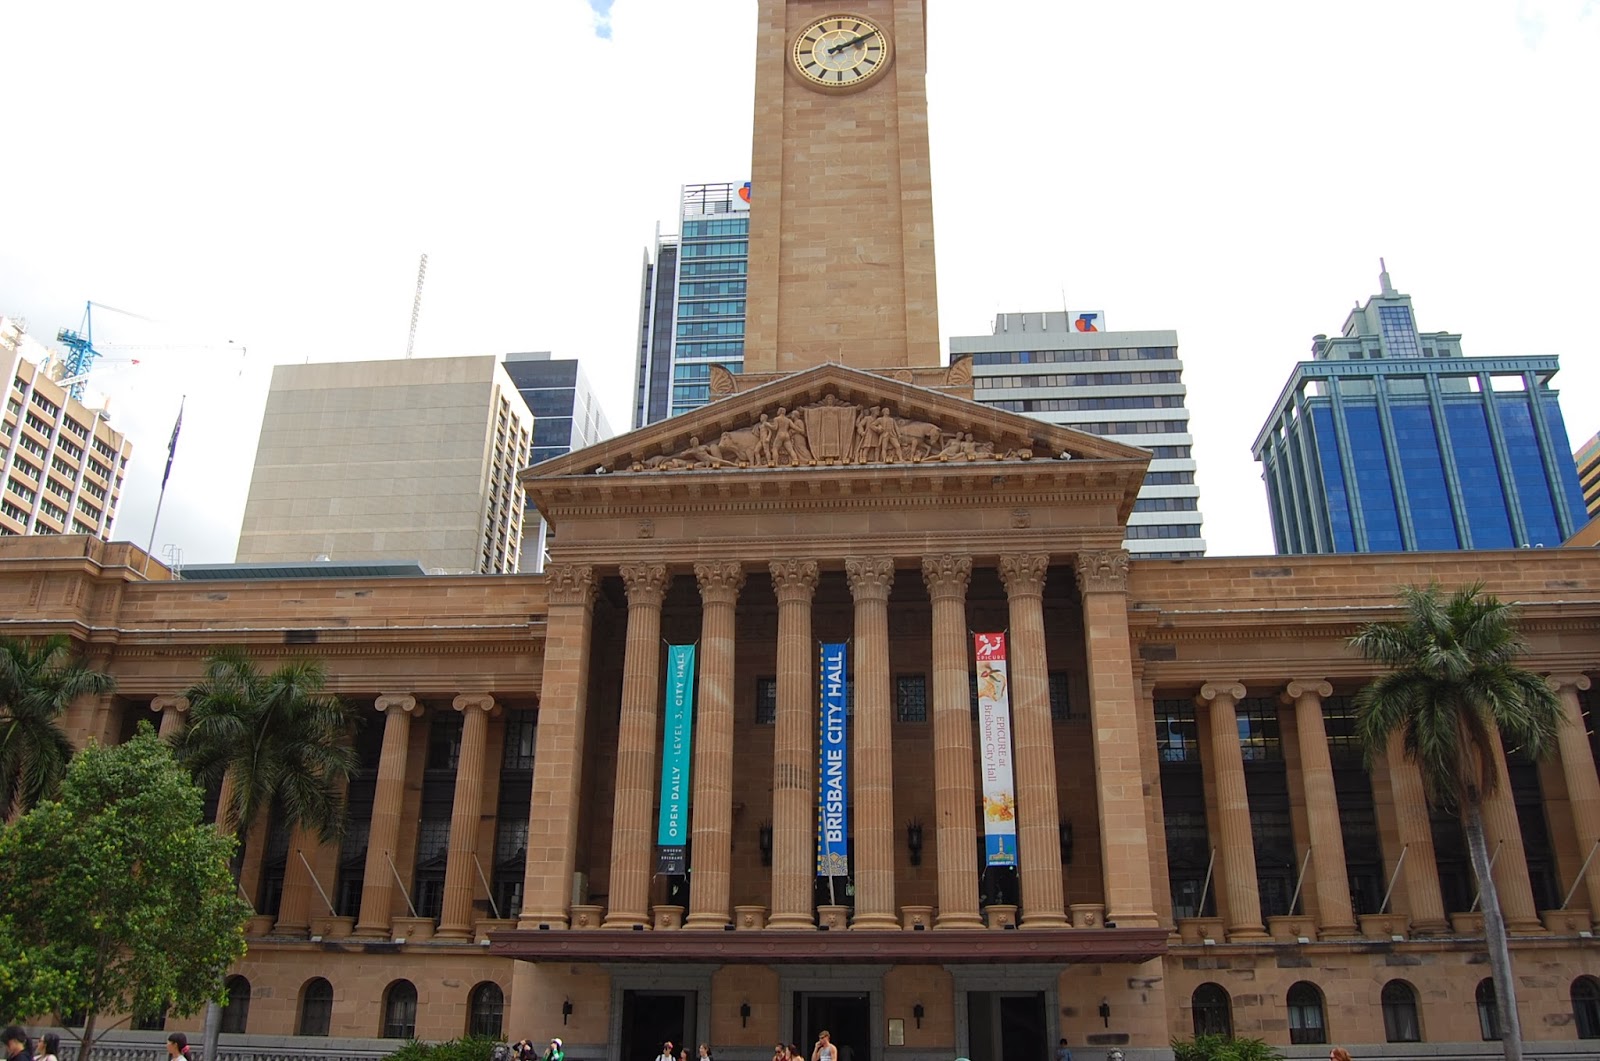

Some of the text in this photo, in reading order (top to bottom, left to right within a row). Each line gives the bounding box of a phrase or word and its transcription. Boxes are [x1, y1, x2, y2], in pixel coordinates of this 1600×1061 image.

[1080, 314, 1097, 331] T
[676, 652, 685, 678] HALL
[676, 680, 684, 706] CITY
[673, 724, 682, 755] LEVEL
[827, 651, 843, 843] BRISBANE CITY HALL
[983, 704, 997, 782] Brisbane City Hall
[996, 716, 1007, 767] EPICURE at
[671, 766, 680, 800] DAILY
[669, 803, 679, 837] OPEN
